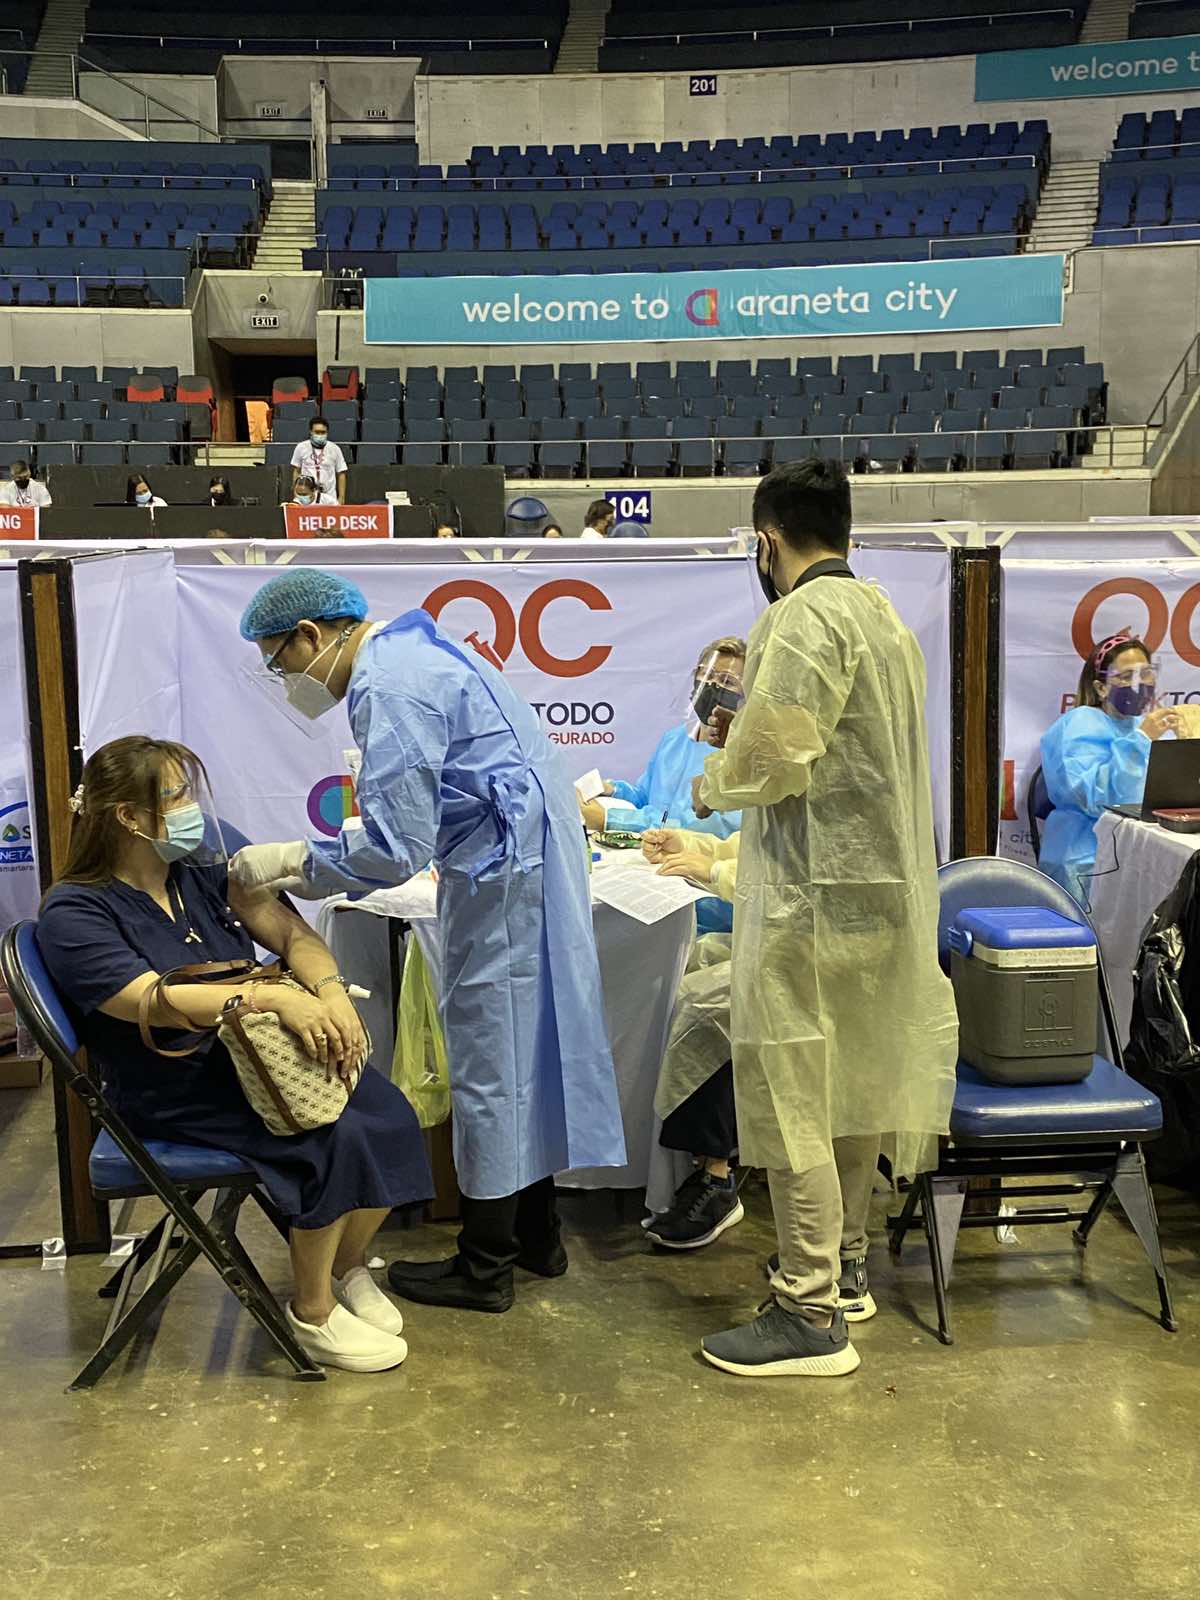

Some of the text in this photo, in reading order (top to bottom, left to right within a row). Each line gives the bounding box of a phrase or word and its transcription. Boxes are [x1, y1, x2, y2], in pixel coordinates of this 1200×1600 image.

[1050, 51, 1200, 82] welcome t
[691, 79, 716, 92] 201
[462, 293, 621, 322] welcome
[631, 293, 669, 320] to
[736, 286, 871, 316] araneta
[885, 281, 958, 319] city
[255, 317, 274, 327] EXIT
[608, 496, 650, 518] 104
[0, 514, 21, 529] NG
[298, 515, 379, 531] HELP DESK
[420, 579, 613, 678] QC
[530, 702, 615, 726] TODO
[548, 731, 615, 745] GURADO
[0, 850, 33, 860] NETA
